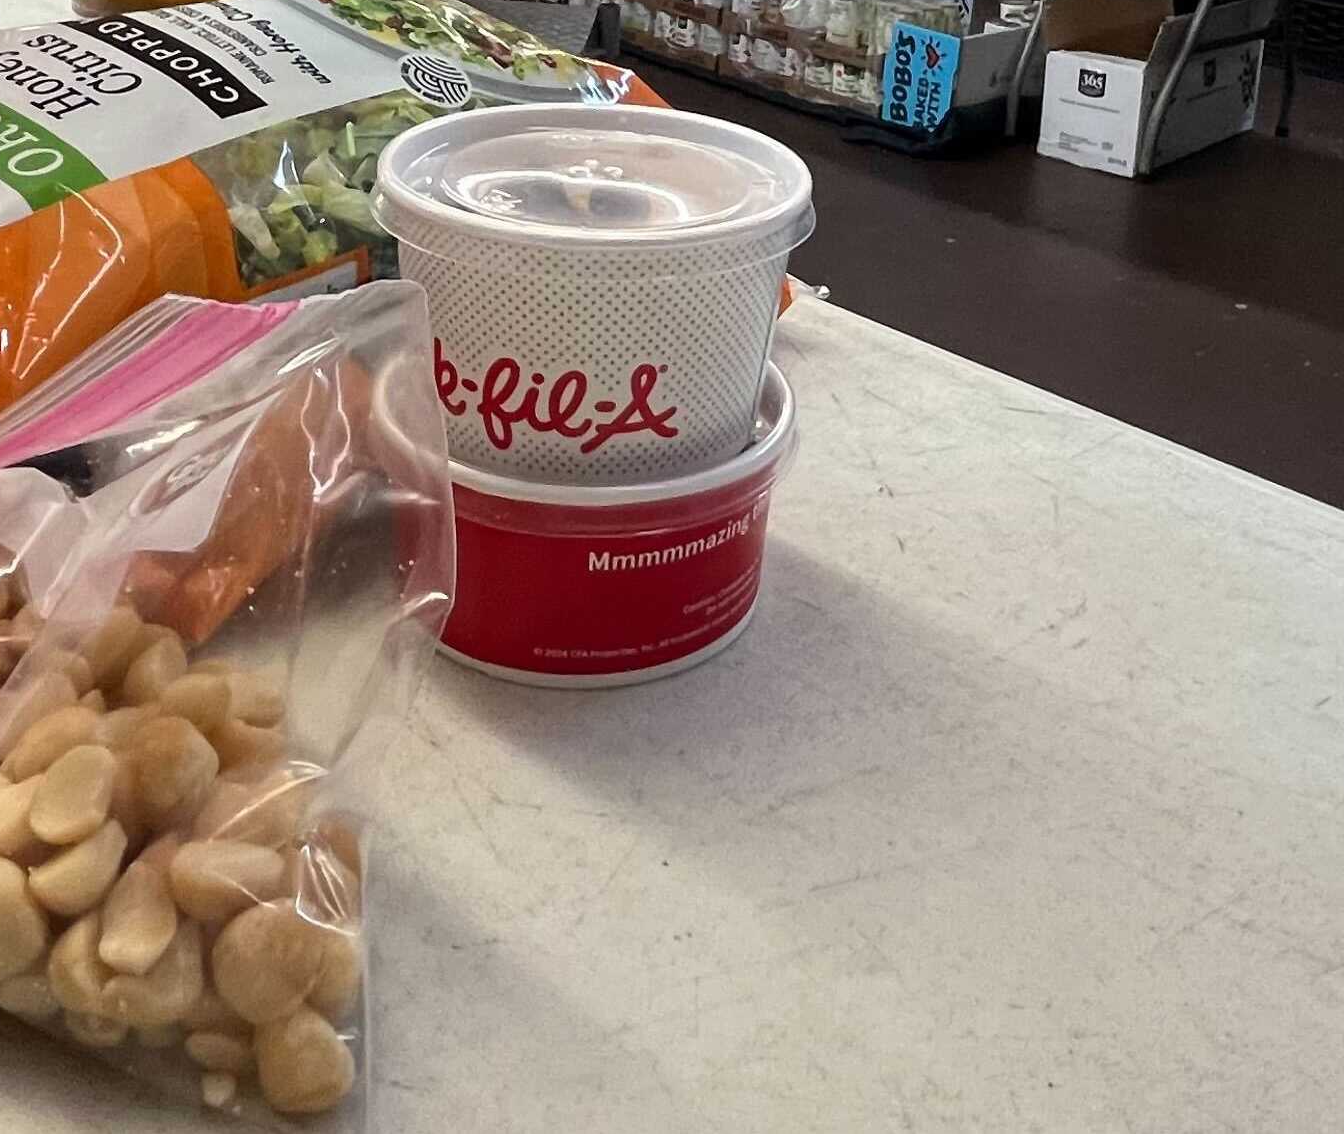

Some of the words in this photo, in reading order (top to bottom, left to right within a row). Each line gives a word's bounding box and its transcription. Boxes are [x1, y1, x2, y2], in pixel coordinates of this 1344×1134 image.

[23, 33, 142, 94] Citrus
[98, 20, 240, 104] CHOPPED
[890, 30, 916, 122] BOBO'S
[1081, 74, 1104, 89] 365
[588, 512, 749, 572] Mmmmmazing
